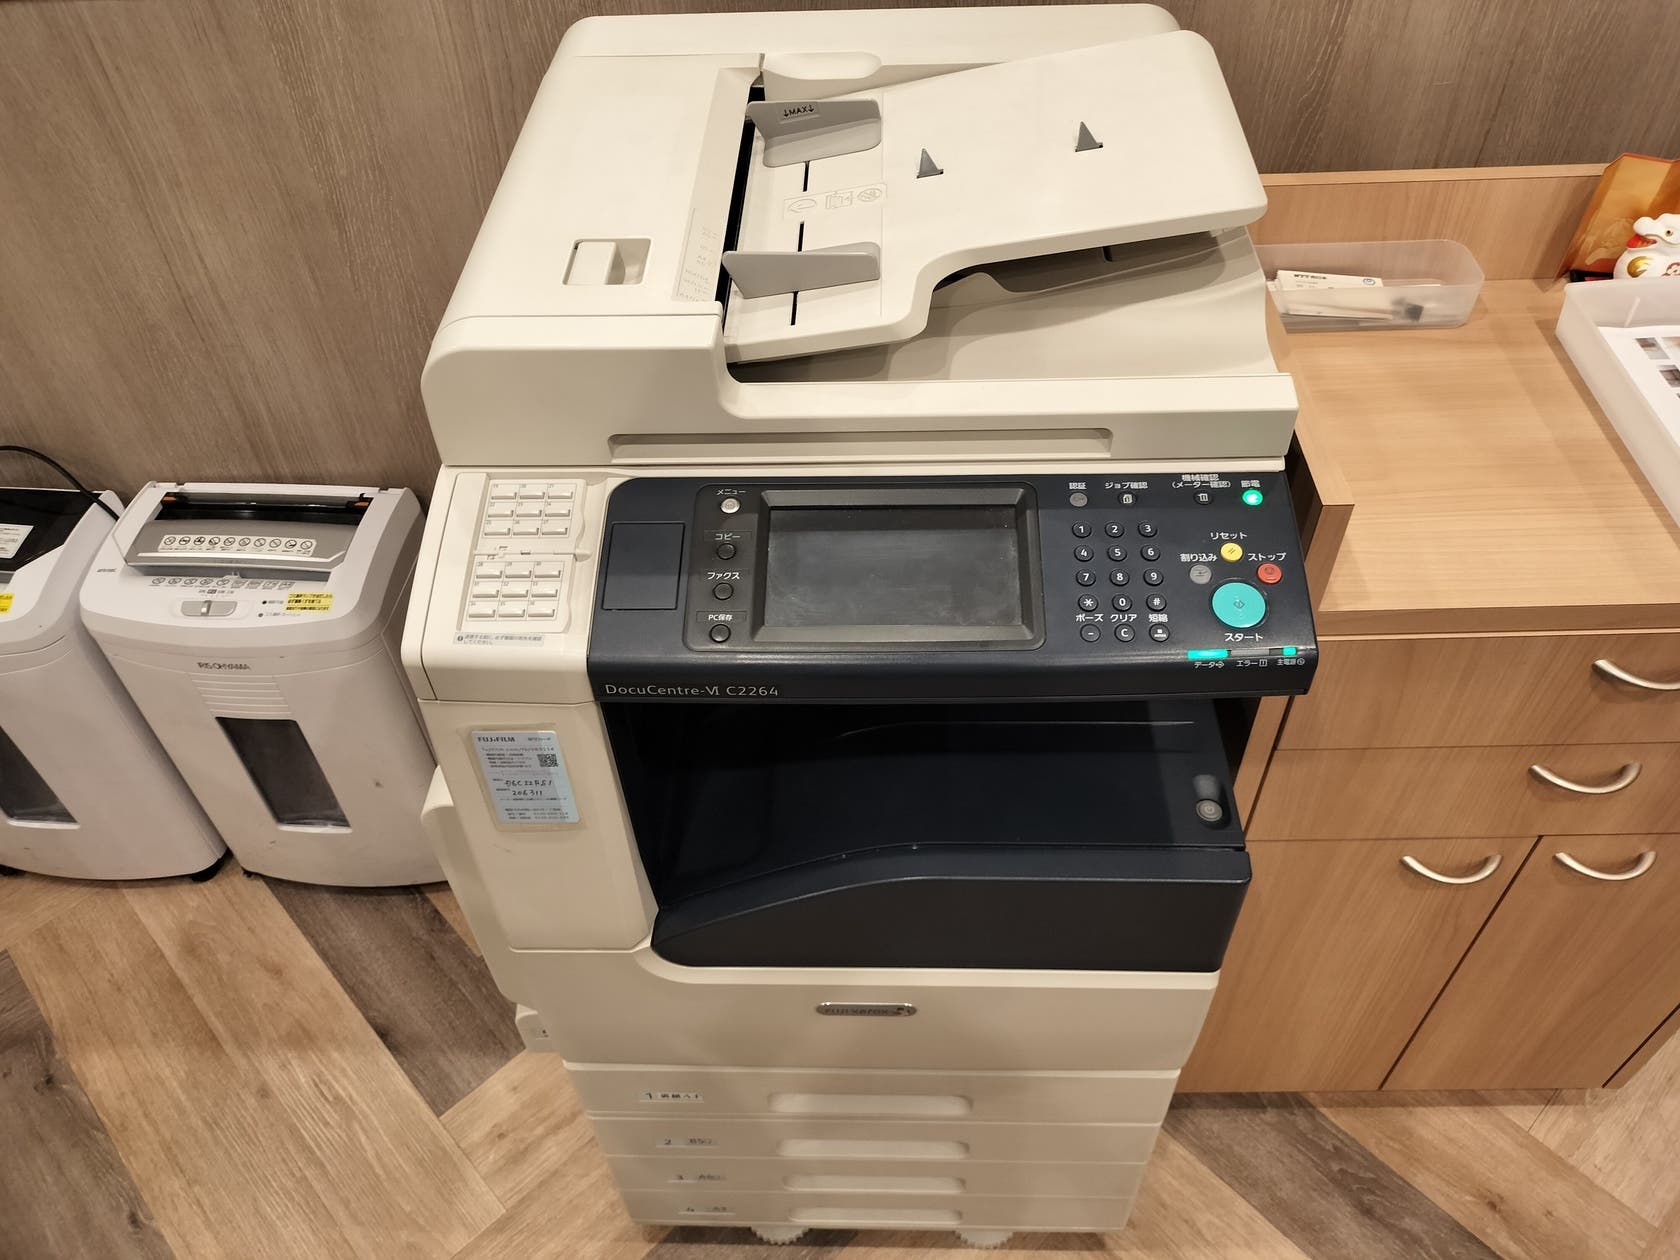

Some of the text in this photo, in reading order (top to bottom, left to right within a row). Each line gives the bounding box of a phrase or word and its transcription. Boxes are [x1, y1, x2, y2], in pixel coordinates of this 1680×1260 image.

[788, 105, 808, 115] MAX
[1104, 481, 1149, 490] ジョブ確認
[1240, 479, 1261, 489] 節電
[716, 488, 746, 496] メニュー
[1078, 525, 1085, 534] 1
[1111, 525, 1119, 534] 2
[1144, 524, 1152, 533] 3
[714, 533, 741, 541] コピー
[1210, 531, 1248, 540] リセット
[1080, 548, 1088, 557] 4
[1114, 548, 1122, 557] 5
[1147, 547, 1155, 557] 6
[1247, 552, 1287, 562] ストップ
[1179, 553, 1218, 563] 割り込み
[706, 572, 741, 581] ファクス
[1082, 572, 1090, 582] 7
[1116, 572, 1124, 582] 8
[1150, 571, 1158, 581] 9
[1118, 597, 1126, 608] 0
[708, 613, 733, 622] PC保存
[1075, 613, 1104, 623] ポーズ
[1109, 613, 1138, 623] クリア
[1148, 613, 1169, 623] 短縮
[1120, 628, 1130, 638] C
[1224, 632, 1264, 642] スタート
[1193, 661, 1215, 669] データ
[1235, 659, 1258, 667] エラー
[725, 686, 779, 697] C2264
